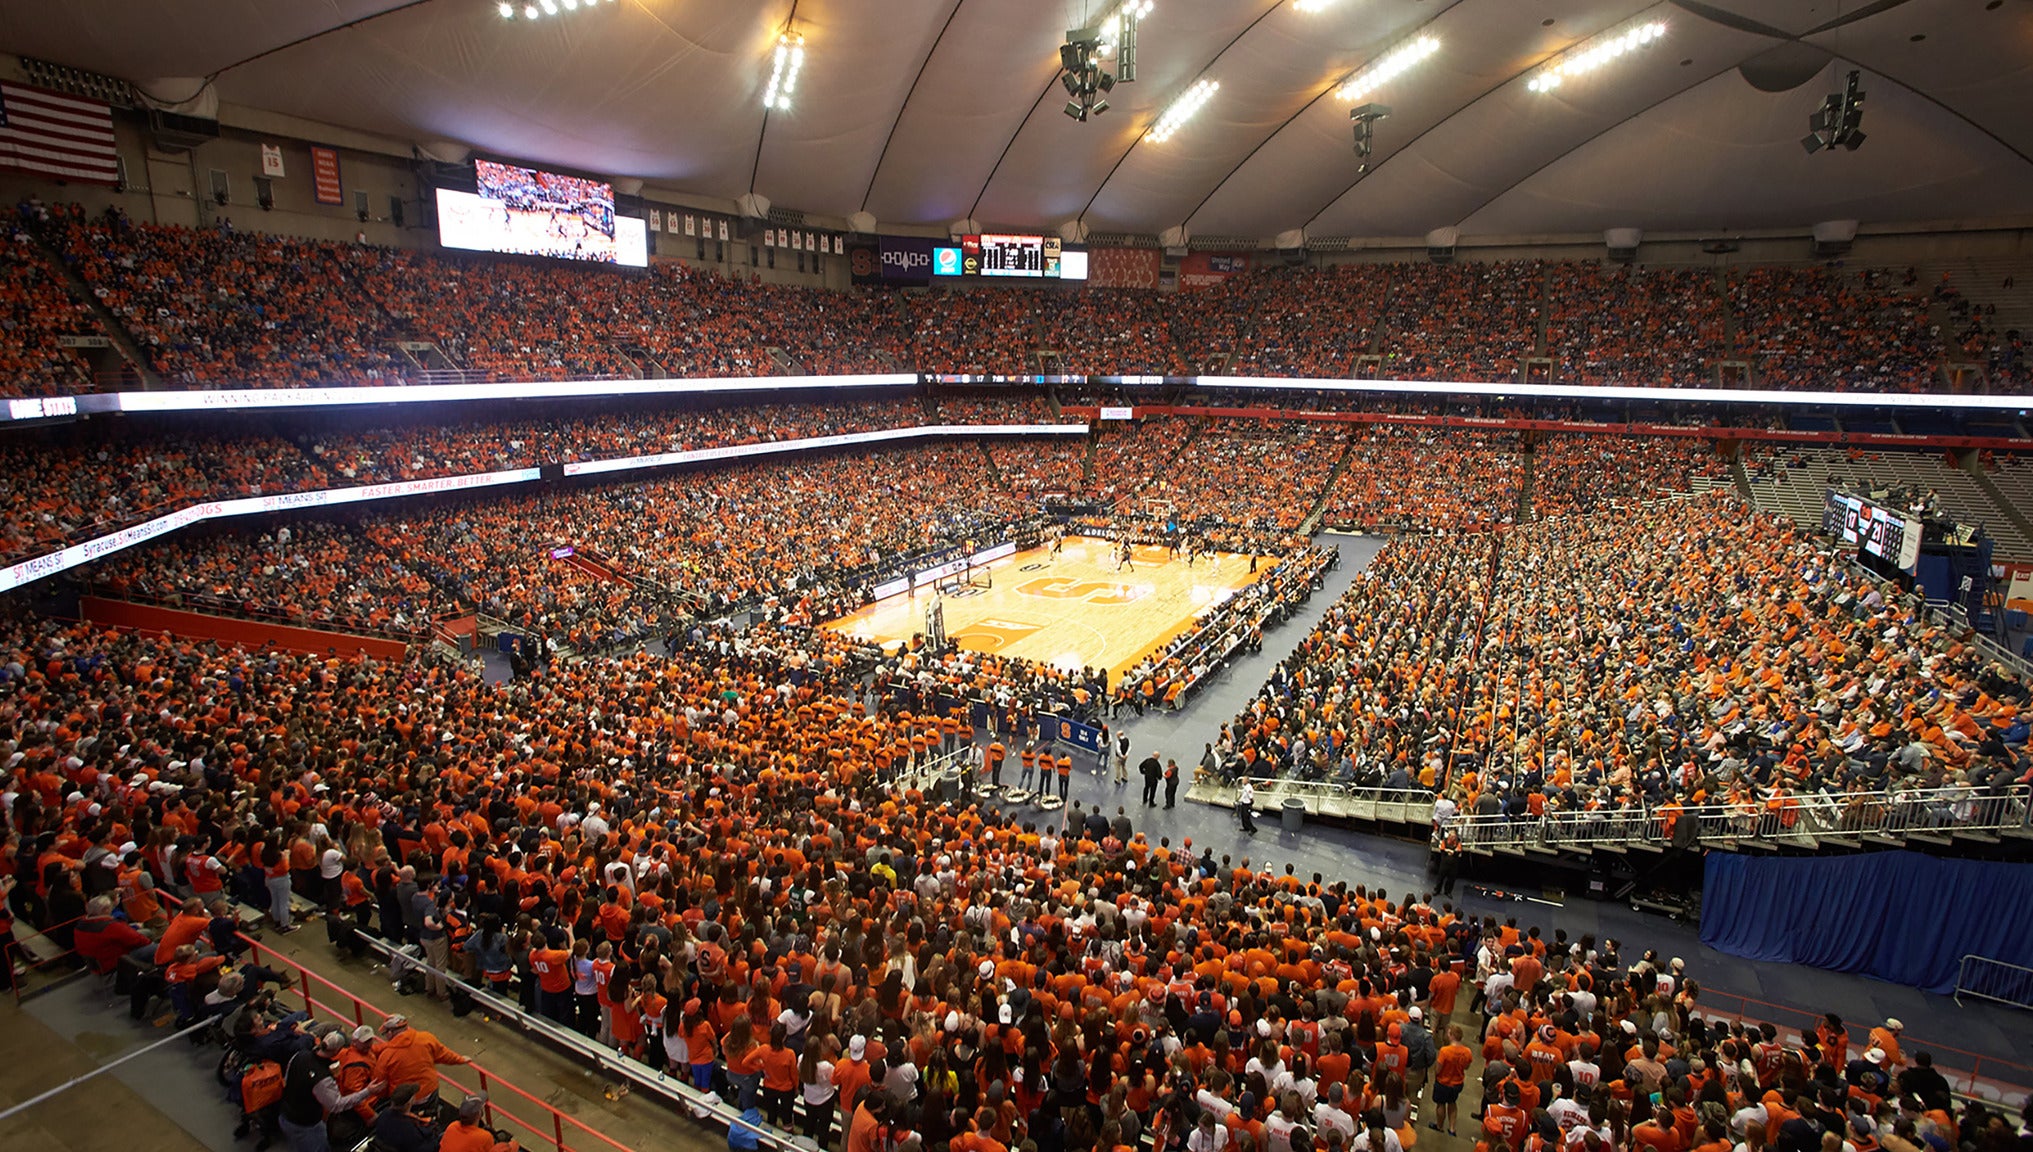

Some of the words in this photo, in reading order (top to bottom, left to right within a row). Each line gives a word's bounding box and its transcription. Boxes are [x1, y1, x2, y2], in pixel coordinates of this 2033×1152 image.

[361, 486, 405, 498] FASTER.
[406, 480, 455, 492] SMARTER.
[457, 475, 494, 487] BETTER.
[278, 494, 314, 504] MEANS
[1848, 510, 1857, 529] 17
[25, 555, 54, 574] MEANS
[534, 960, 549, 973] 10
[594, 969, 606, 985] 10
[1531, 1049, 1555, 1061] BEAT
[1578, 1071, 1594, 1086] 10
